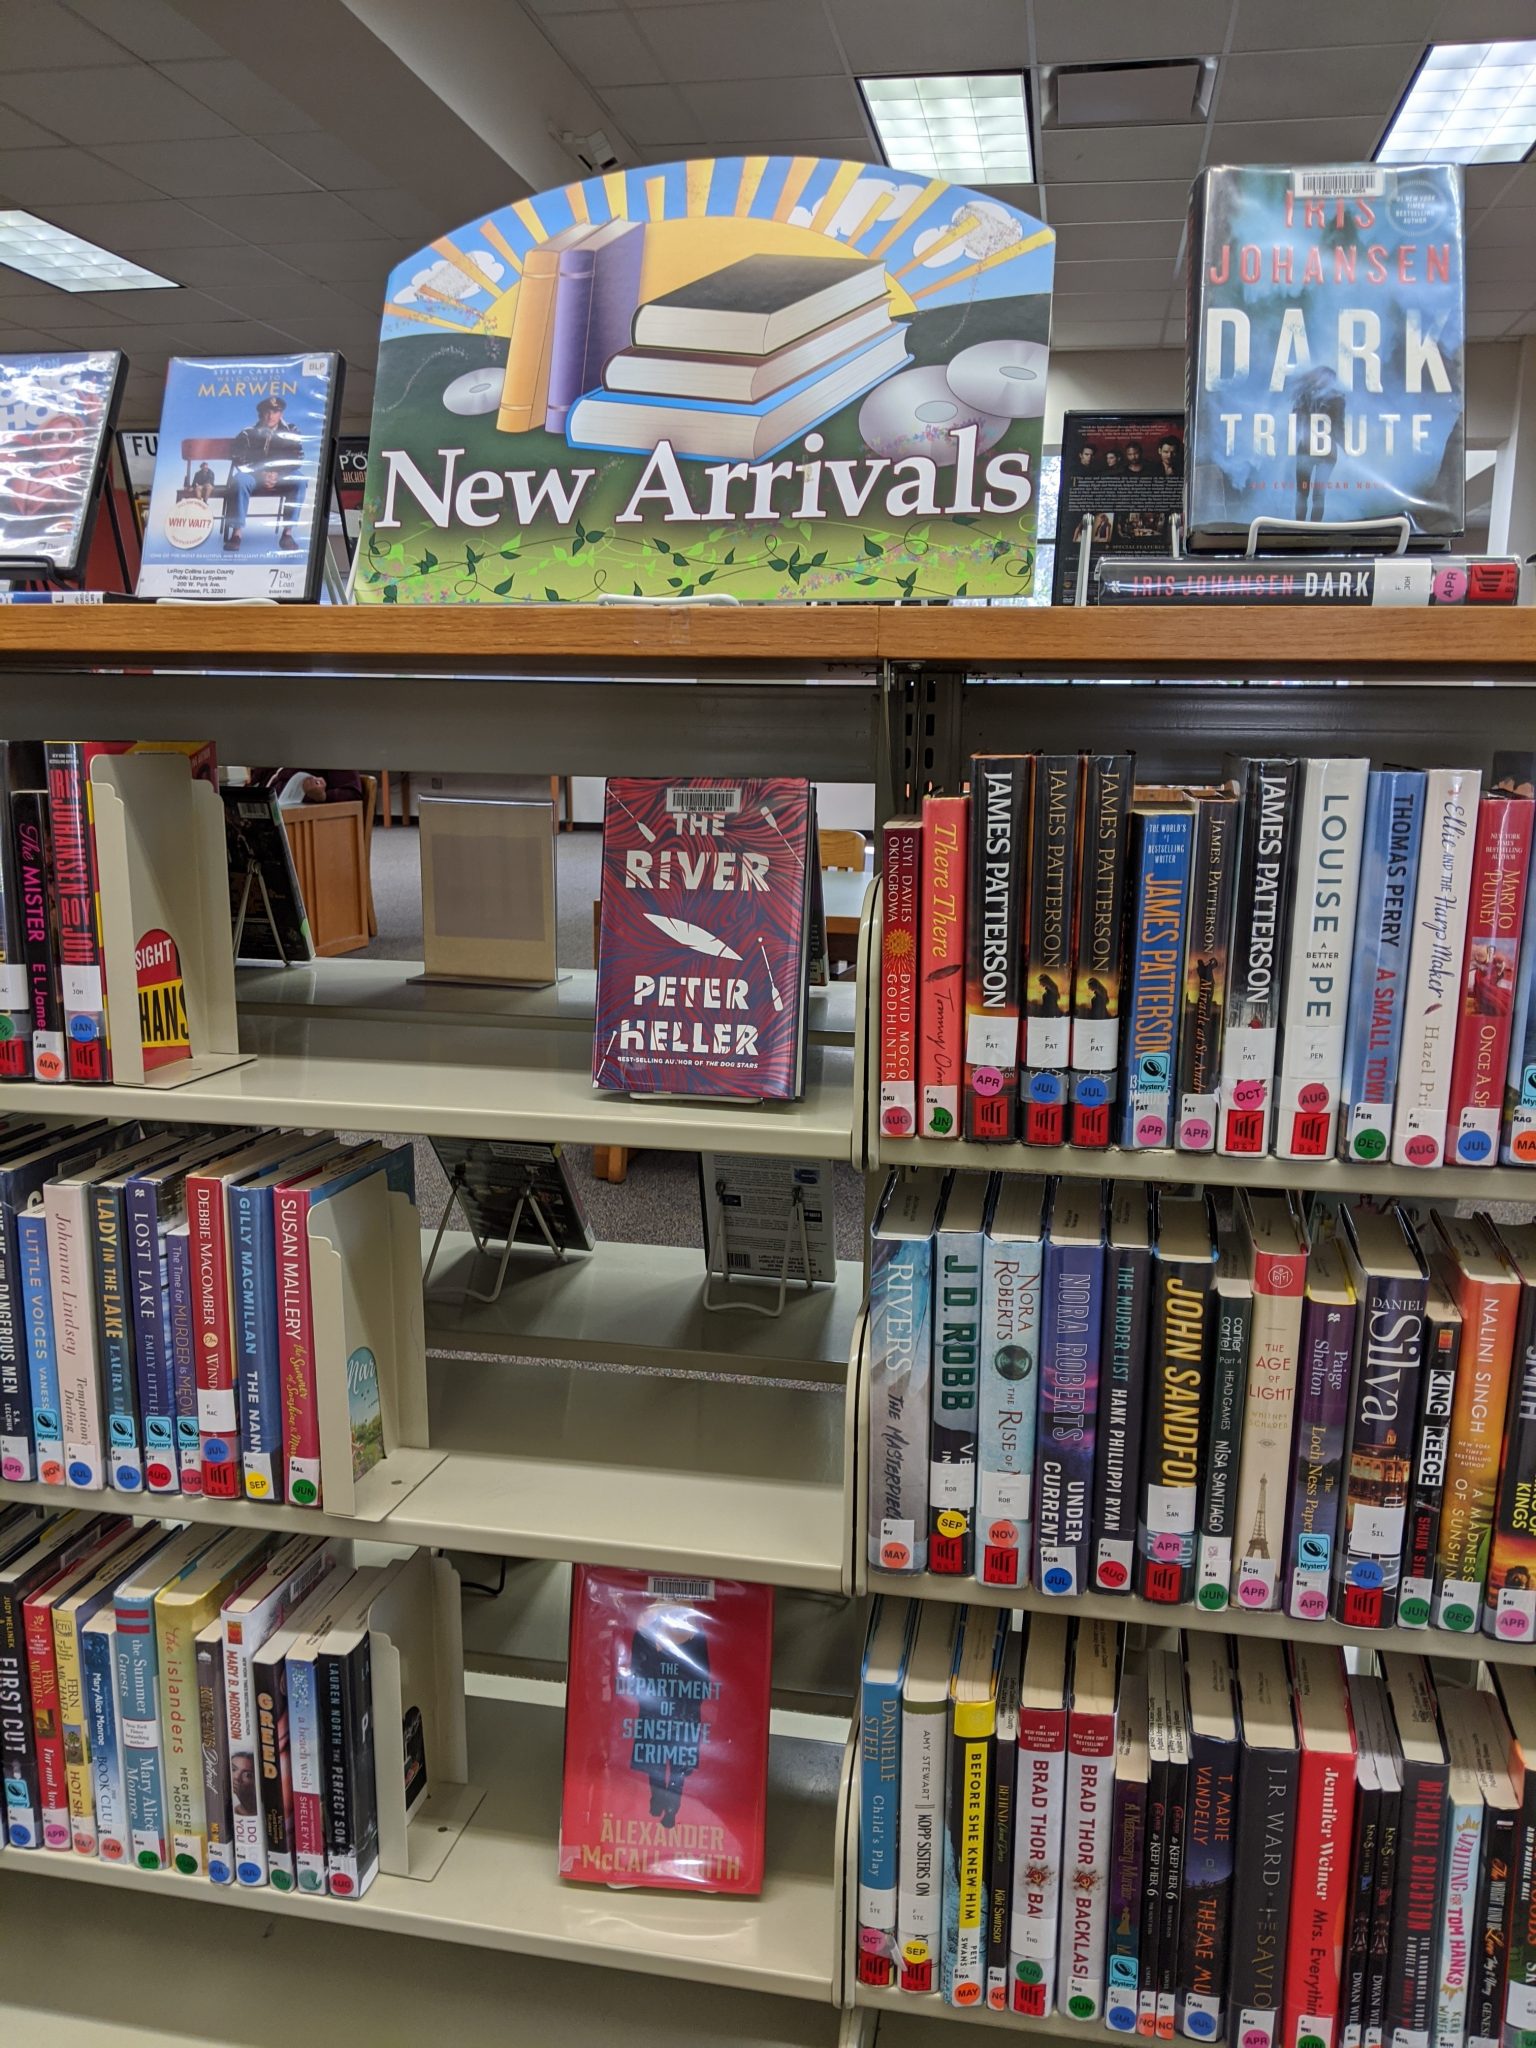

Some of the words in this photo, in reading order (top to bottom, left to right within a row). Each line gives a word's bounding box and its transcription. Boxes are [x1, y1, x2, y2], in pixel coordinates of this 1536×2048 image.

[1286, 190, 1375, 229] IRIS
[1210, 245, 1450, 285] JOHANSEN
[309, 362, 324, 370] BLP
[1206, 308, 1452, 394] DARK
[198, 381, 297, 397] MARWEN
[1221, 414, 1432, 457] TRIBUTE
[375, 448, 596, 528] New
[616, 424, 1032, 524] Arrivals
[168, 518, 186, 528] WHY
[189, 519, 211, 528] WAIT?
[269, 569, 278, 588] 7
[1132, 576, 1174, 598] IRIS
[1182, 574, 1294, 596] JOHANSEN
[1305, 572, 1368, 598] DARK
[673, 813, 725, 836] THE
[984, 772, 1012, 854] JAMES
[1050, 769, 1067, 837] JAMES
[1101, 773, 1119, 840] JAMES
[1260, 777, 1286, 857] JAMES
[19, 823, 40, 862] The
[902, 837, 913, 864] SUYI
[1162, 824, 1186, 832] WORLD'S
[1210, 817, 1225, 864] JAMES
[1388, 794, 1415, 878] THOMAS
[626, 851, 770, 892] RIVER
[888, 836, 899, 922] OKUNGBOWA
[934, 824, 956, 888] There
[1155, 855, 1176, 863] WRITER
[1313, 795, 1348, 932] LOUISE
[22, 866, 44, 942] MISTER
[901, 876, 912, 922] DAVIES
[1044, 844, 1066, 968] PATTERSON
[1094, 847, 1116, 973] PATTERSON
[1142, 873, 1182, 942] JAMES
[1204, 870, 1224, 953] PATTERSON
[1382, 882, 1406, 947] PERRY
[1480, 870, 1502, 928] PUTNEY
[933, 895, 956, 958] There
[982, 861, 1010, 1009] PATTERSON
[1247, 863, 1280, 1003] PATTERSON
[32, 964, 46, 972] E
[136, 938, 172, 970] SIGHT
[1377, 968, 1396, 984] A
[634, 976, 748, 1010] PETER
[900, 975, 910, 1024] DAVID
[1134, 948, 1177, 1060] PATTERSON
[620, 1020, 758, 1056] HELLER
[886, 975, 898, 1080] GODHUNTER
[1370, 989, 1396, 1050] SMALL
[618, 1056, 663, 1064] BEST-SELLING
[899, 1029, 910, 1080] MOGO
[1422, 1026, 1439, 1073] Hazel
[1478, 1026, 1496, 1070] ONCE
[1476, 1074, 1492, 1086] A
[135, 1212, 150, 1261] LOST
[240, 1197, 252, 1244] GILLY
[282, 1200, 297, 1256] SUSAN
[24, 1229, 41, 1288] LITTLE
[56, 1214, 71, 1286] Johanna
[138, 1268, 154, 1318] LAKE
[284, 1262, 301, 1340] MALLERY
[942, 1256, 978, 1312] J.D.
[994, 1260, 1014, 1340] ROBERTS
[1116, 1266, 1134, 1288] THE
[0, 1284, 16, 1362] DANGEROUS
[62, 1294, 79, 1356] Lindsey
[241, 1252, 256, 1354] MACMILLAN
[887, 1262, 914, 1373] RIVERS
[1018, 1272, 1040, 1332] NORA
[1056, 1274, 1090, 1332] NORA
[1115, 1295, 1132, 1350] MURDER
[1166, 1278, 1203, 1358] JOHN
[1372, 1298, 1423, 1311] DANIEL
[32, 1296, 48, 1360] VOICES
[145, 1335, 156, 1370] EMILY
[1478, 1299, 1500, 1365] NALINI
[2, 1365, 18, 1394] MEN
[942, 1324, 977, 1410] ROBB
[1112, 1356, 1129, 1382] LIST
[1256, 1356, 1290, 1370] AGE
[1311, 1339, 1329, 1396] Shelton
[1328, 1351, 1348, 1389] Paige
[1360, 1312, 1423, 1425] Silva
[247, 1372, 258, 1404] THE
[888, 1394, 904, 1420] THE
[1052, 1343, 1087, 1442] ROBERTS
[1110, 1388, 1128, 1425] HANK
[1250, 1384, 1293, 1400] LIGHT
[1426, 1371, 1454, 1415] KING
[1472, 1373, 1492, 1434] SINGH
[248, 1410, 261, 1454] NANN
[1214, 1440, 1228, 1468] NISA
[1310, 1426, 1326, 1460] Loch
[1107, 1430, 1126, 1494] PHILLIPPI
[1307, 1464, 1322, 1496] Ness
[1418, 1428, 1448, 1486] REECE
[1065, 1482, 1084, 1542] UNDER
[1104, 1498, 1120, 1531] RYAN
[1209, 1472, 1227, 1532] SANTIAGO
[1512, 1483, 1532, 1529] KINGS
[1, 1658, 22, 1714] FIRST
[328, 1664, 339, 1704] LAUREN
[616, 1677, 722, 1700] DEPARTMENT
[660, 1662, 678, 1676] THE
[4, 1719, 26, 1754] CUT
[332, 1708, 342, 1745] NORTH
[623, 1718, 711, 1745] SENSITIVE
[880, 1700, 896, 1783] DANIELLE
[633, 1745, 698, 1766] CRIMES
[332, 1766, 344, 1816] PERFECT
[967, 1753, 982, 1810] BEFORE
[1031, 1760, 1049, 1808] BRAD
[1080, 1764, 1097, 1812] BRAD
[1265, 1767, 1287, 1809] J.R.
[1321, 1767, 1339, 1839] Jennifer
[966, 1814, 979, 1838] SHE
[1192, 1767, 1212, 1846] VANDELLY
[1414, 1780, 1444, 1847] MICHAEL
[335, 1821, 346, 1845] SON
[1030, 1815, 1048, 1860] THOR
[1078, 1820, 1095, 1864] THOR
[1262, 1811, 1283, 1886] WARD
[965, 1844, 979, 1886] KNEW
[1316, 1840, 1334, 1901] Weiner
[964, 1891, 976, 1921] HIM
[1408, 1855, 1436, 1930] CRICHTON
[1314, 1909, 1329, 1941] Mrs.
[1252, 1935, 1275, 2008] SAVIO
[1306, 1948, 1325, 2015] Everythin
